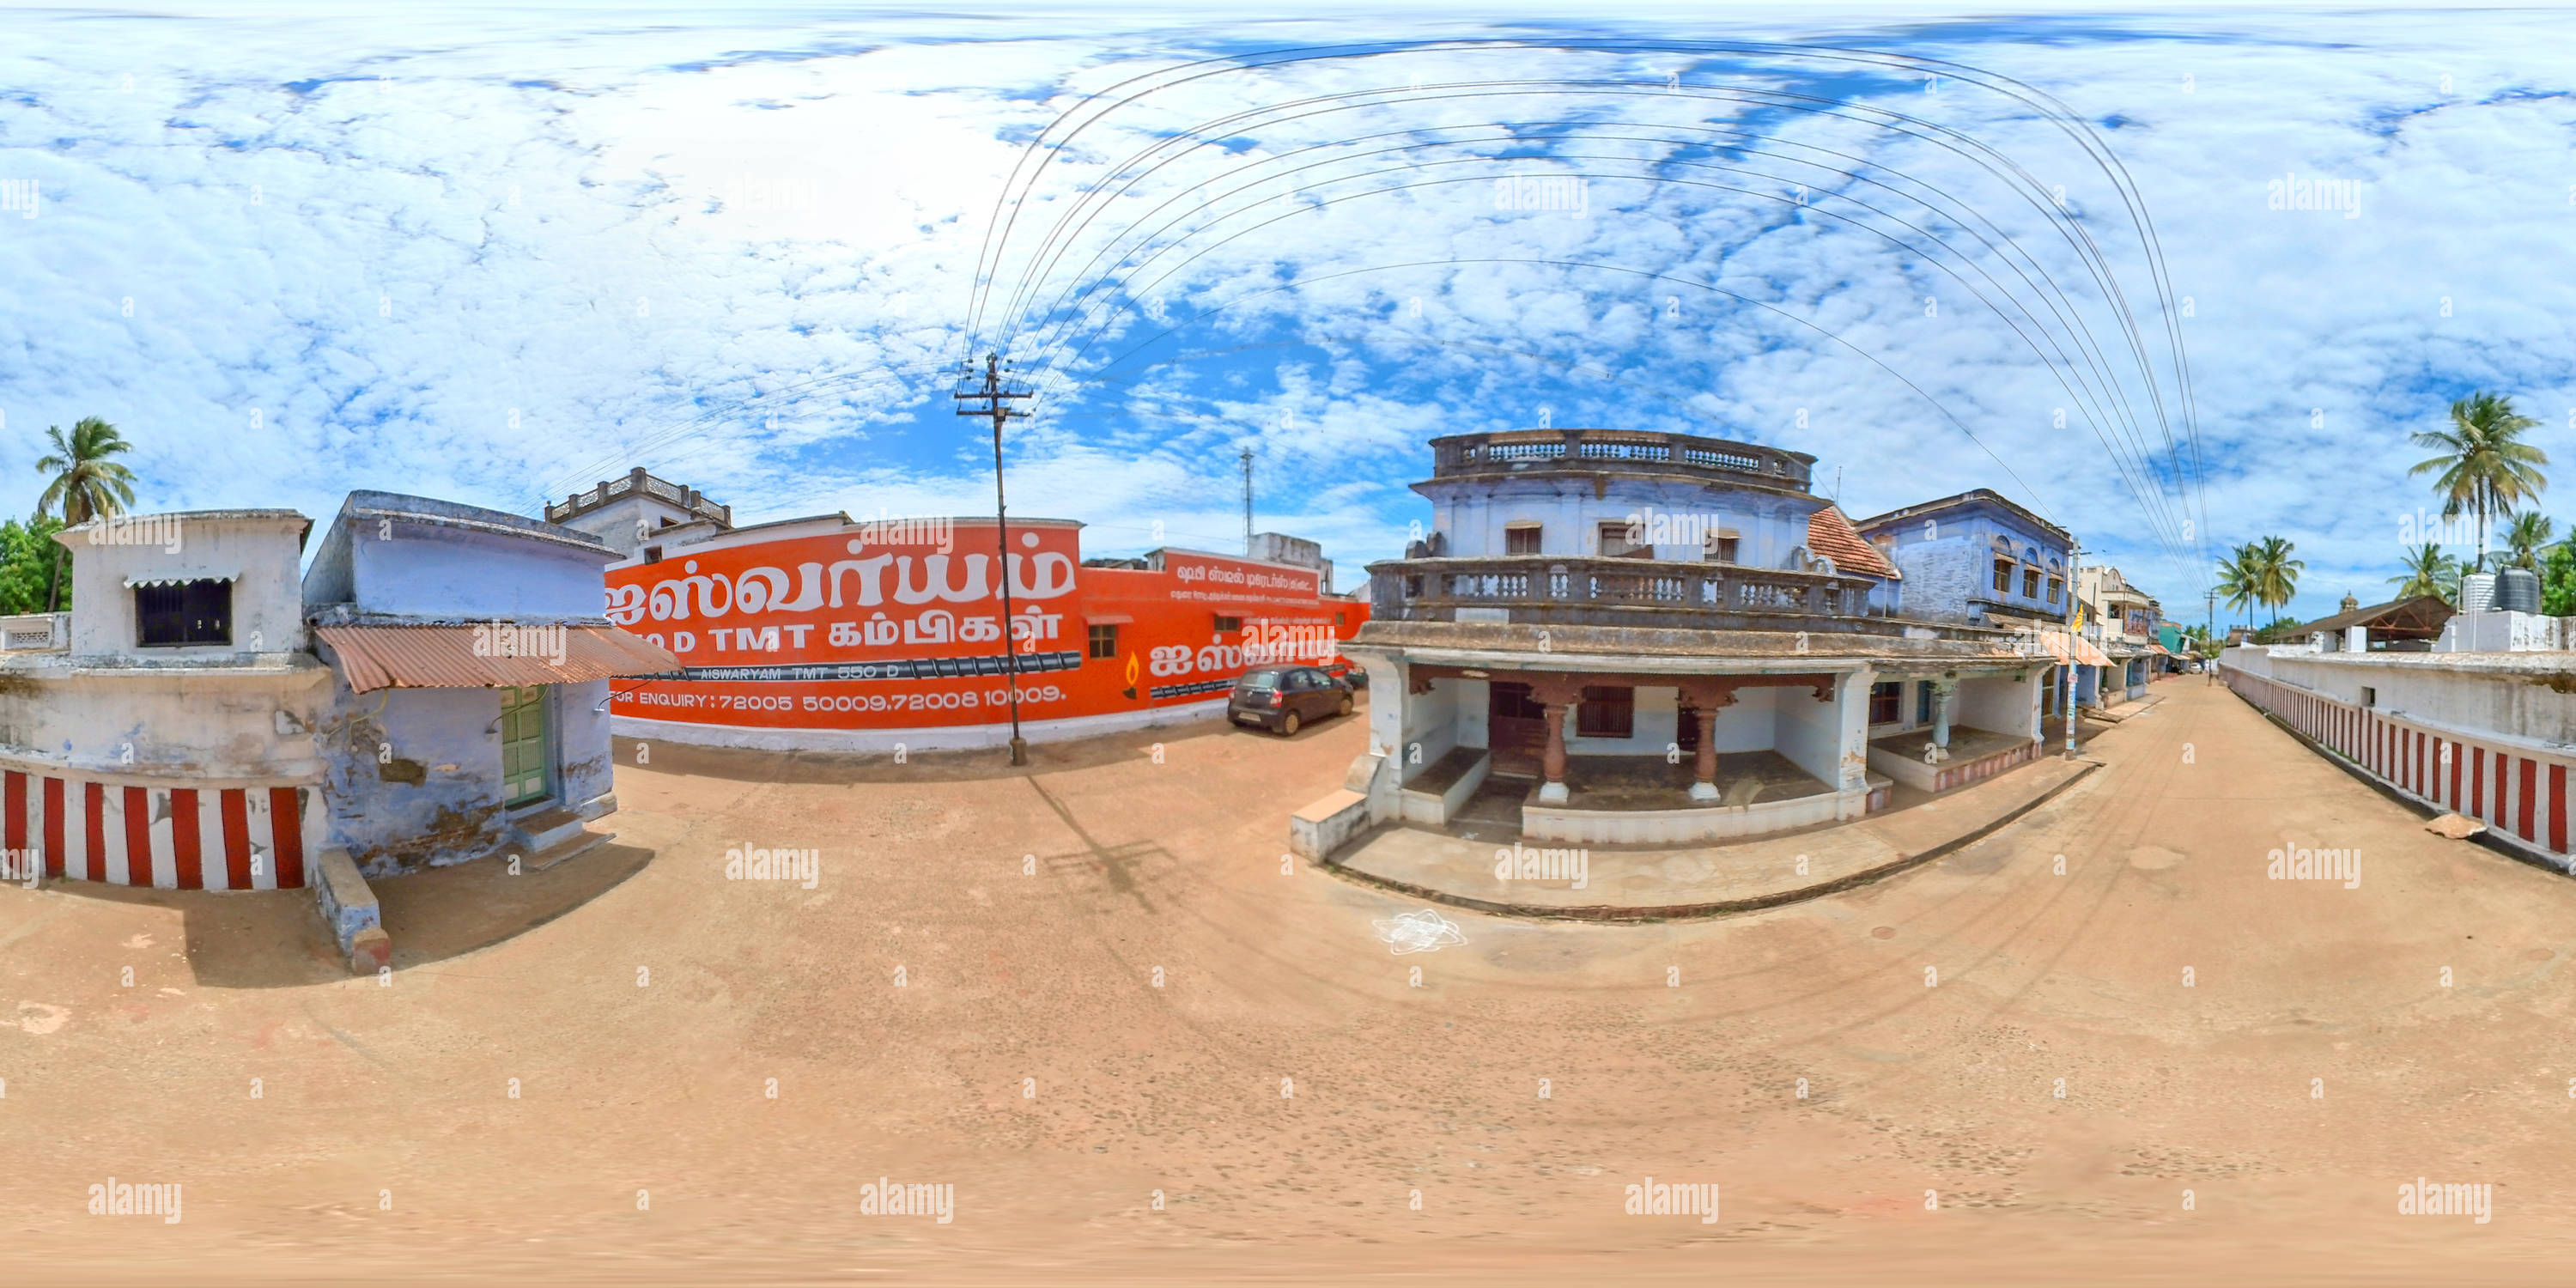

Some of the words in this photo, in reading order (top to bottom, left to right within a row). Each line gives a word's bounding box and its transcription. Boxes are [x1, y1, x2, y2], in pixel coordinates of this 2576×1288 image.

[674, 631, 696, 653] D
[708, 624, 815, 652] TMT
[828, 605, 1063, 647] கம்பிகள்
[701, 668, 781, 680] AISWARYAM
[792, 667, 828, 679] TMT
[837, 665, 877, 679] 550
[886, 665, 900, 678] D
[609, 690, 634, 703] FOR
